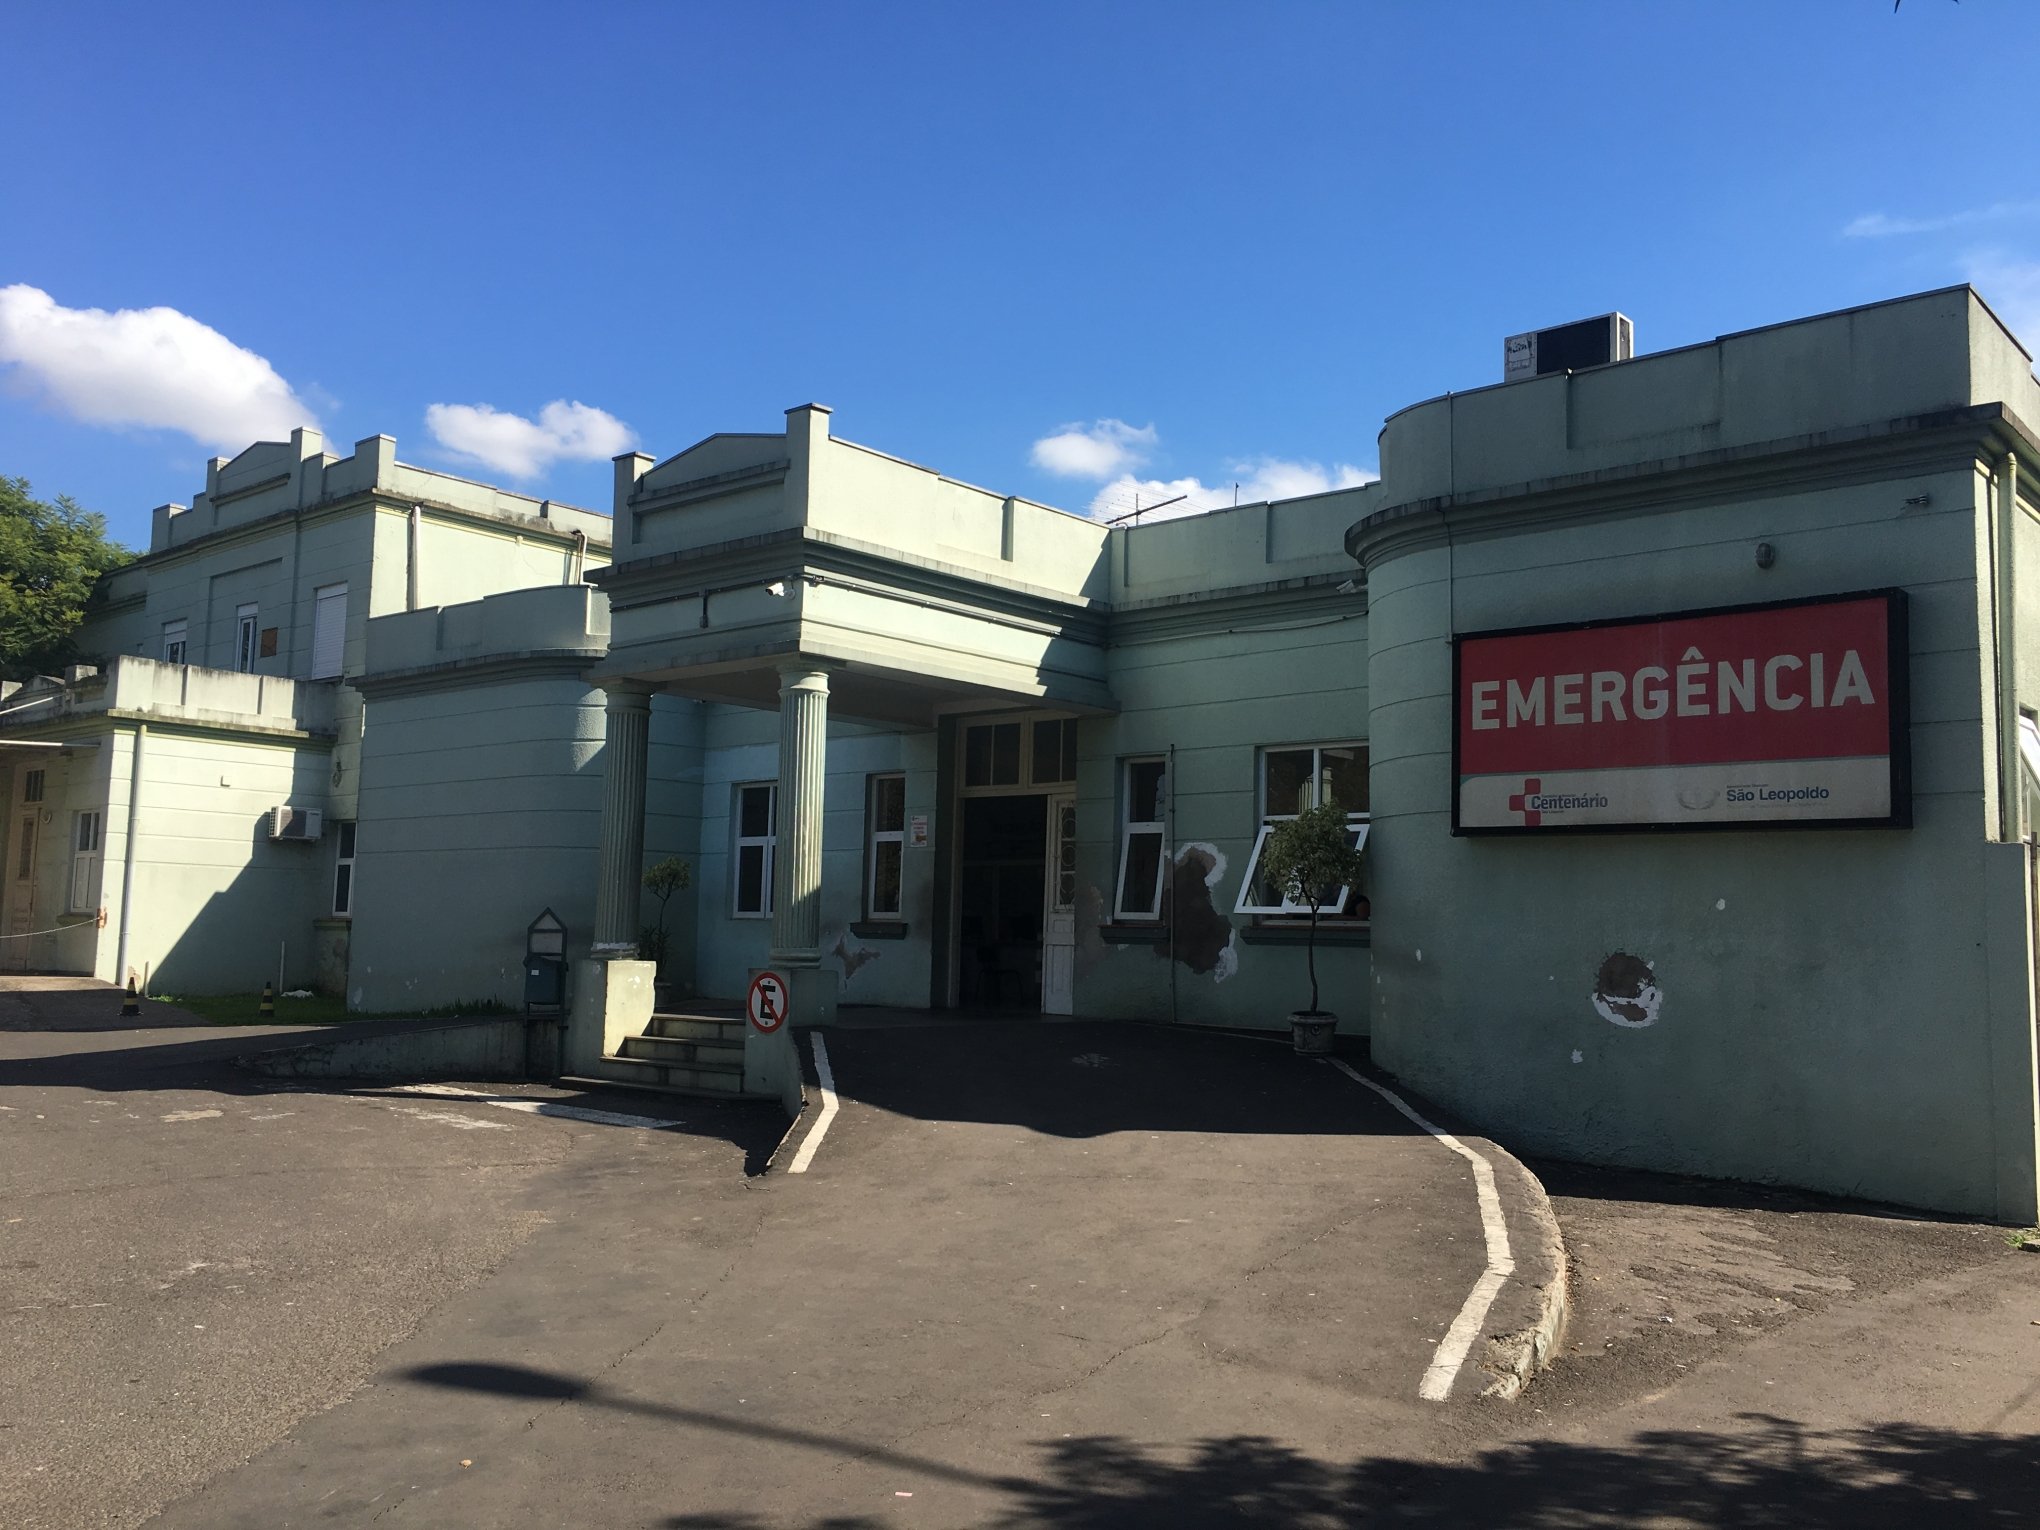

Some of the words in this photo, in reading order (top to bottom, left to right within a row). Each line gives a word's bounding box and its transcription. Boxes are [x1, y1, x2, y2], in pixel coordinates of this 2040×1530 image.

[1471, 646, 1875, 731] EMERGÊNCIA
[1531, 793, 1609, 810] Centenário
[1726, 788, 1755, 802] São
[1759, 786, 1830, 803] Leopoldo
[759, 984, 776, 1020] E
